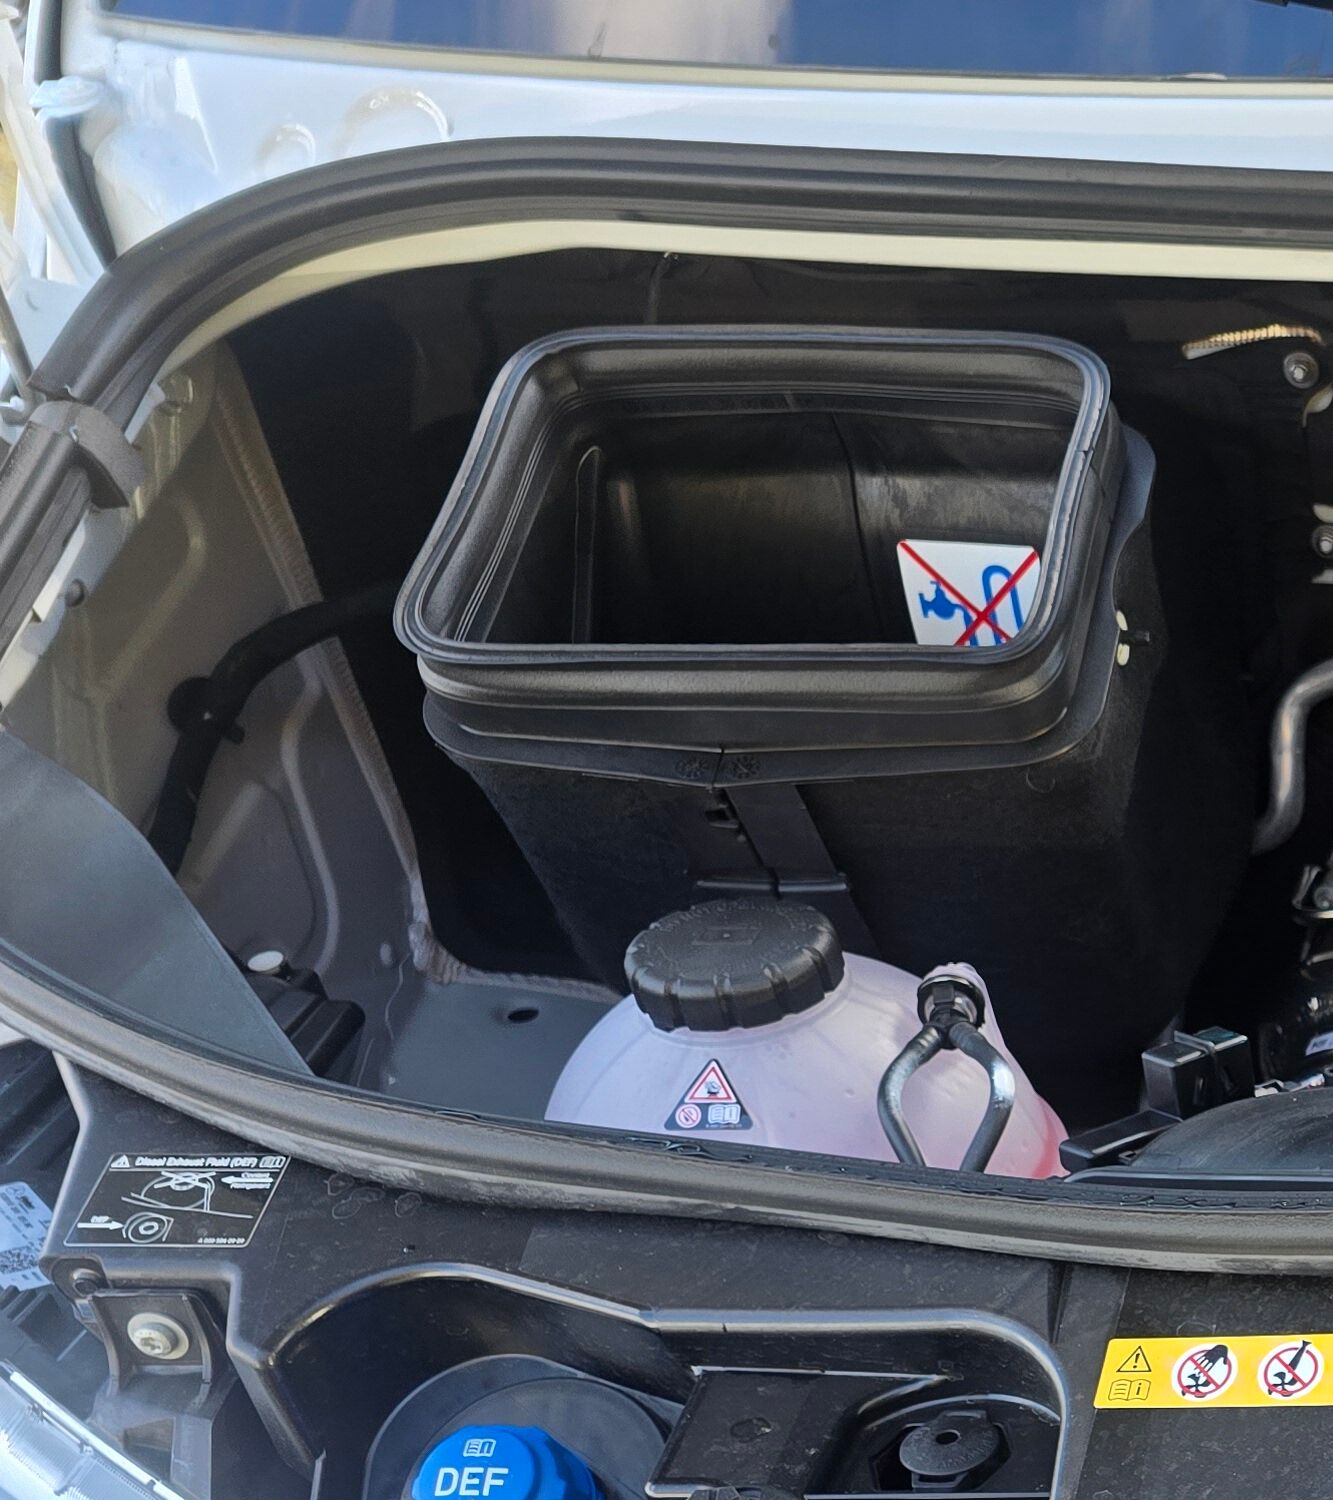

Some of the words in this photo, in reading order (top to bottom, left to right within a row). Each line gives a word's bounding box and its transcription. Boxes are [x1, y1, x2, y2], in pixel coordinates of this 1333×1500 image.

[135, 1156, 167, 1167] Diesel
[166, 1156, 205, 1167] Exhaust
[205, 1156, 231, 1167] Fluid
[230, 1156, 258, 1168] (DEF)
[434, 1466, 509, 1497] DEF
